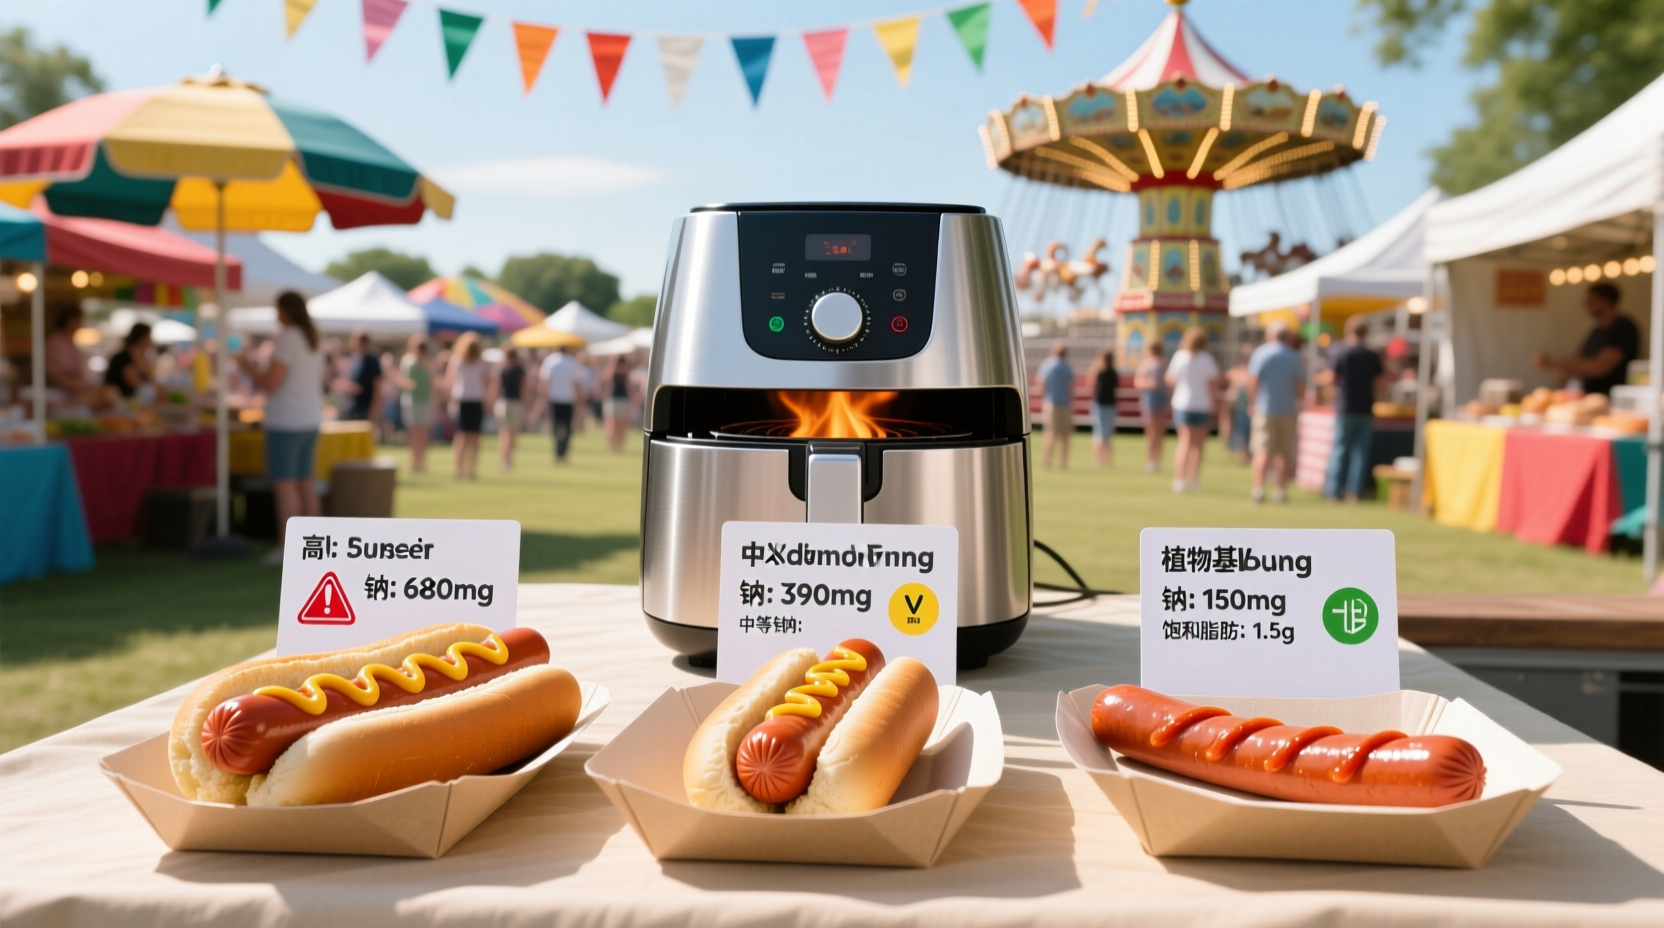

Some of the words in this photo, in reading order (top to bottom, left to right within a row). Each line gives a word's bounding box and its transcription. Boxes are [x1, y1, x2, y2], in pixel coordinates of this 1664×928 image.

[403, 576, 494, 608] 680mg
[780, 582, 872, 613] 390mg
[904, 594, 924, 616] V
[1202, 588, 1286, 617] 150mg
[1252, 621, 1295, 645] 1.5g
